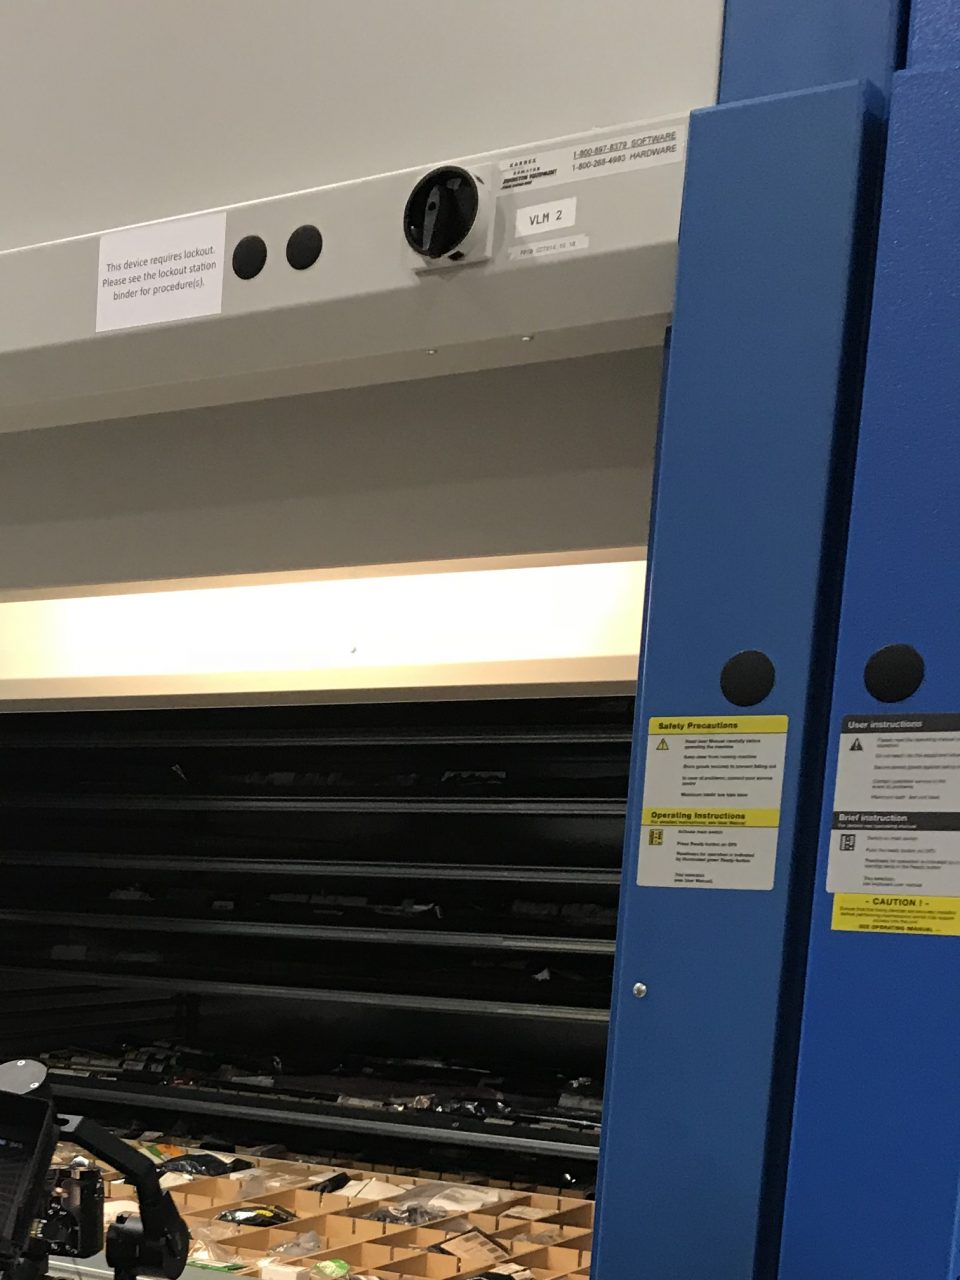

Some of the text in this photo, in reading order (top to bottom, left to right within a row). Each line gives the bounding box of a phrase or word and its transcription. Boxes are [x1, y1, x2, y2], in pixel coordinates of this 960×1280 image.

[631, 130, 677, 149] SOFTWARE
[629, 144, 677, 161] HARDWARE
[529, 209, 563, 226] VLM 2
[106, 246, 216, 273] This device requires lockout.
[102, 260, 217, 288] Please see the lockout station
[113, 288, 138, 301] binder
[140, 286, 151, 296] for
[658, 721, 738, 731] Safety Precautions
[847, 720, 868, 729] User
[651, 811, 746, 821] Operating Instructions
[838, 813, 908, 822] Brief instruction
[872, 897, 916, 906] CAUTION
